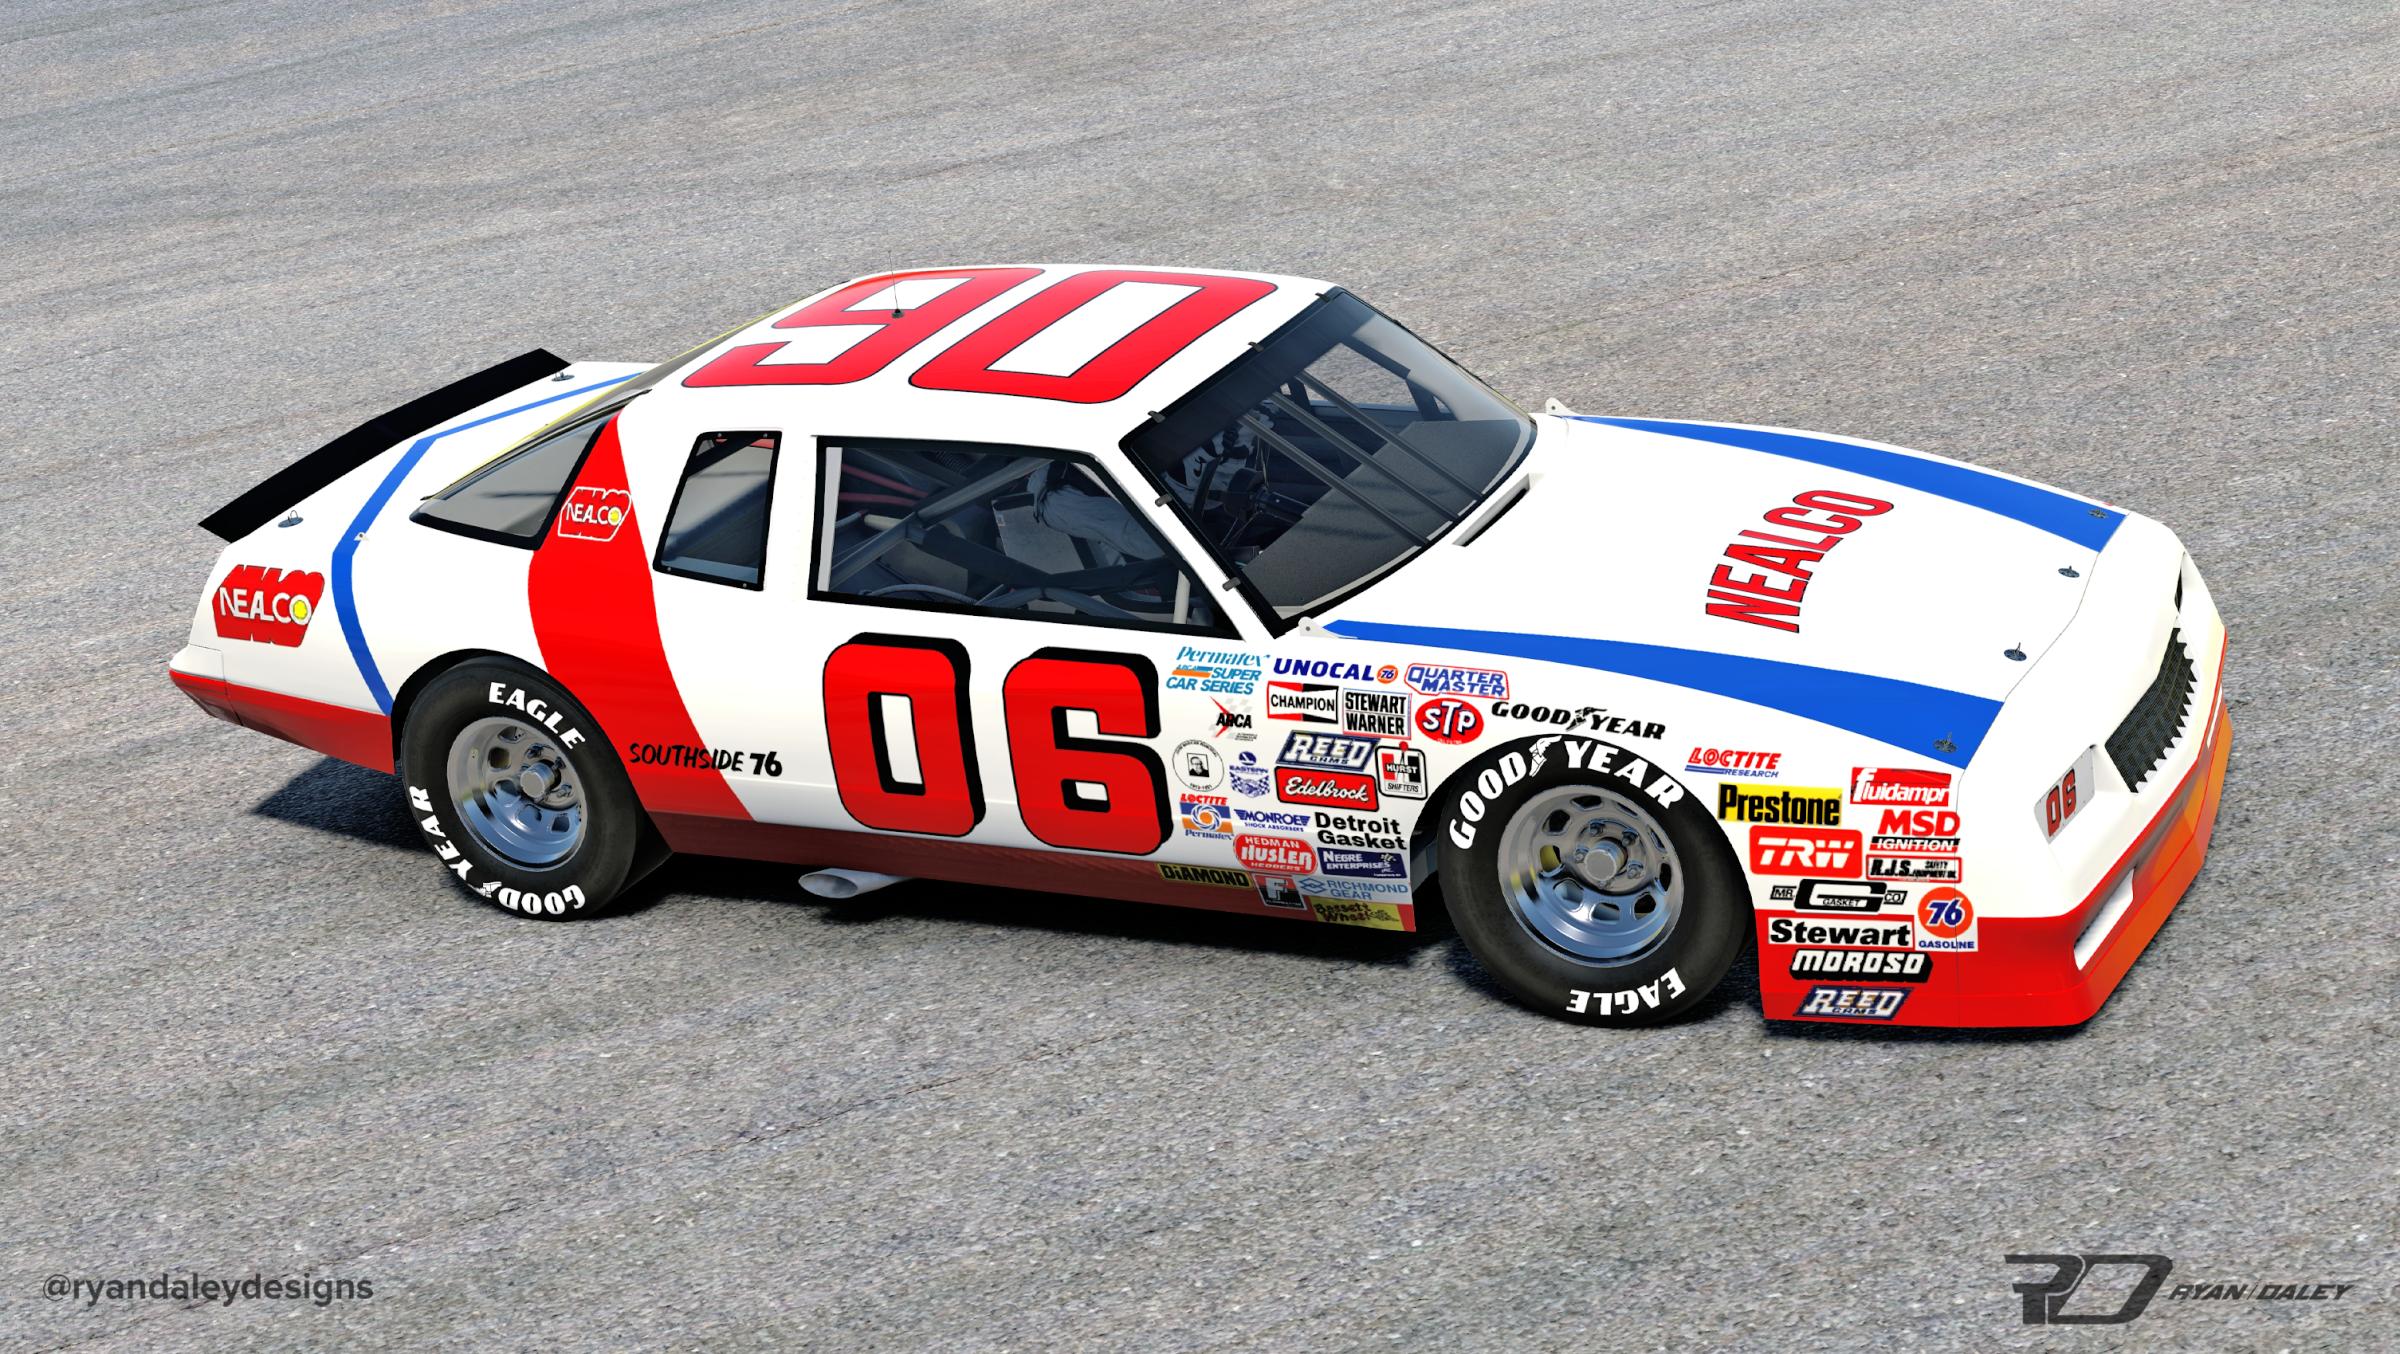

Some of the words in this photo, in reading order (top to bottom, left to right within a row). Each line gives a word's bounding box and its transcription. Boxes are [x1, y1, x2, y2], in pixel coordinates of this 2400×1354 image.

[565, 503, 622, 526] NEALCO
[1705, 490, 1894, 634] NEALCO
[219, 586, 313, 625] NEALCO
[1176, 646, 1263, 667] Permatex
[1211, 667, 1262, 681] SUPER
[1273, 658, 1375, 681] UNOCAL
[1379, 667, 1395, 680] 76
[1408, 666, 1504, 686] QUARTER
[1166, 676, 1198, 690] CAR
[1200, 680, 1254, 695] SERIES
[1421, 678, 1505, 697] MASTER
[1271, 694, 1335, 711] CHAMPION
[1345, 692, 1407, 714] STEWART
[489, 682, 585, 749] EAGLE
[1216, 712, 1253, 729] ARCA
[1346, 715, 1405, 736] WARNER
[1422, 701, 1477, 738] STP
[823, 632, 1174, 856] 06
[1284, 733, 1372, 768] REED
[629, 743, 744, 772] SOUTHSIDE
[749, 750, 783, 777] 76
[1386, 763, 1418, 774] HURST
[1688, 747, 1782, 770] LOCTITE
[1229, 765, 1269, 774] EASTERN
[1724, 767, 1779, 779] RESEARCH
[1284, 776, 1369, 802] Edelbrock
[1387, 782, 1419, 793] SHIFTERS
[1181, 793, 1228, 805] LOCTITE
[1720, 784, 1840, 826] Prestone
[2046, 768, 2077, 837] 06
[1243, 811, 1303, 826] MONROE
[1315, 812, 1402, 835] Detroit
[1877, 809, 1960, 836] MSD
[1245, 836, 1300, 849] HEDMAN
[1317, 829, 1407, 850] Gasket
[1876, 838, 1955, 852] IGNITION
[1323, 850, 1363, 863] NEGRE
[1757, 837, 1854, 869] TRW
[1327, 861, 1391, 870] ENTERPRISES
[1327, 879, 1408, 894] RICHMOND
[1331, 889, 1372, 900] GEAR
[1821, 898, 1861, 907] GASKET
[1925, 899, 1963, 926] 76
[1770, 919, 1911, 947] Stewart
[1919, 940, 1975, 950] GASOLINE
[1791, 950, 1926, 975] MOROSO
[1566, 967, 1686, 1015] EAGLE
[1801, 987, 1905, 1018] REED
